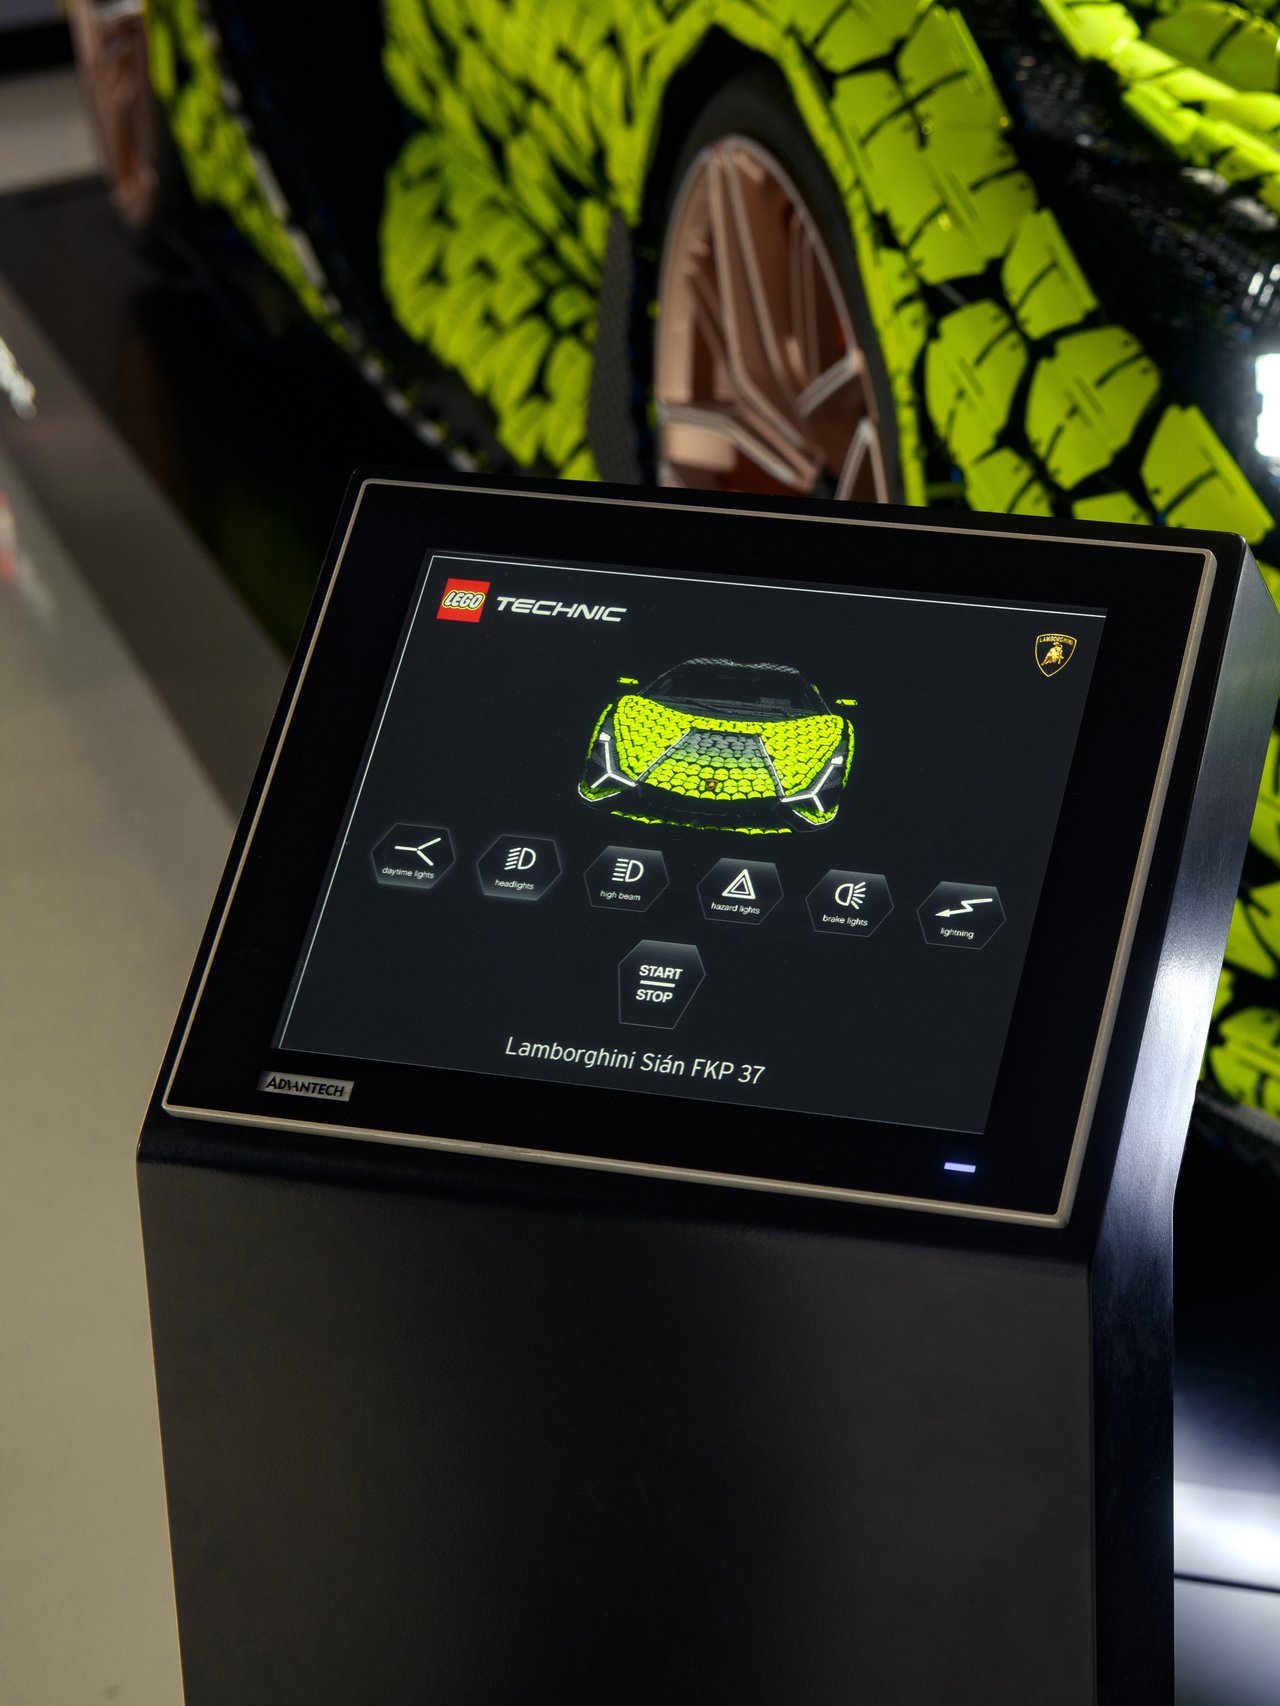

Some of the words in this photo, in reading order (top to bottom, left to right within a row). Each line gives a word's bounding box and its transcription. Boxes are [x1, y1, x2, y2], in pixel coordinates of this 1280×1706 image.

[442, 590, 485, 610] LEGO
[496, 596, 627, 622] TECHNIC
[381, 867, 413, 878] daytime
[414, 870, 434, 880] lights
[494, 878, 535, 891] headlights
[600, 889, 617, 900] high
[619, 891, 641, 901] beam
[710, 901, 737, 911] hazard
[738, 905, 760, 915] lights
[822, 914, 846, 924] brake
[847, 917, 868, 927] lights
[940, 927, 975, 939] lightning
[638, 965, 683, 980] START
[635, 989, 674, 1003] STOP
[505, 1036, 637, 1069] Lamborghini
[640, 1052, 685, 1076] Sián
[690, 1059, 735, 1080] FKP
[737, 1064, 766, 1085] 37
[266, 1075, 345, 1097] ADVANTECH
